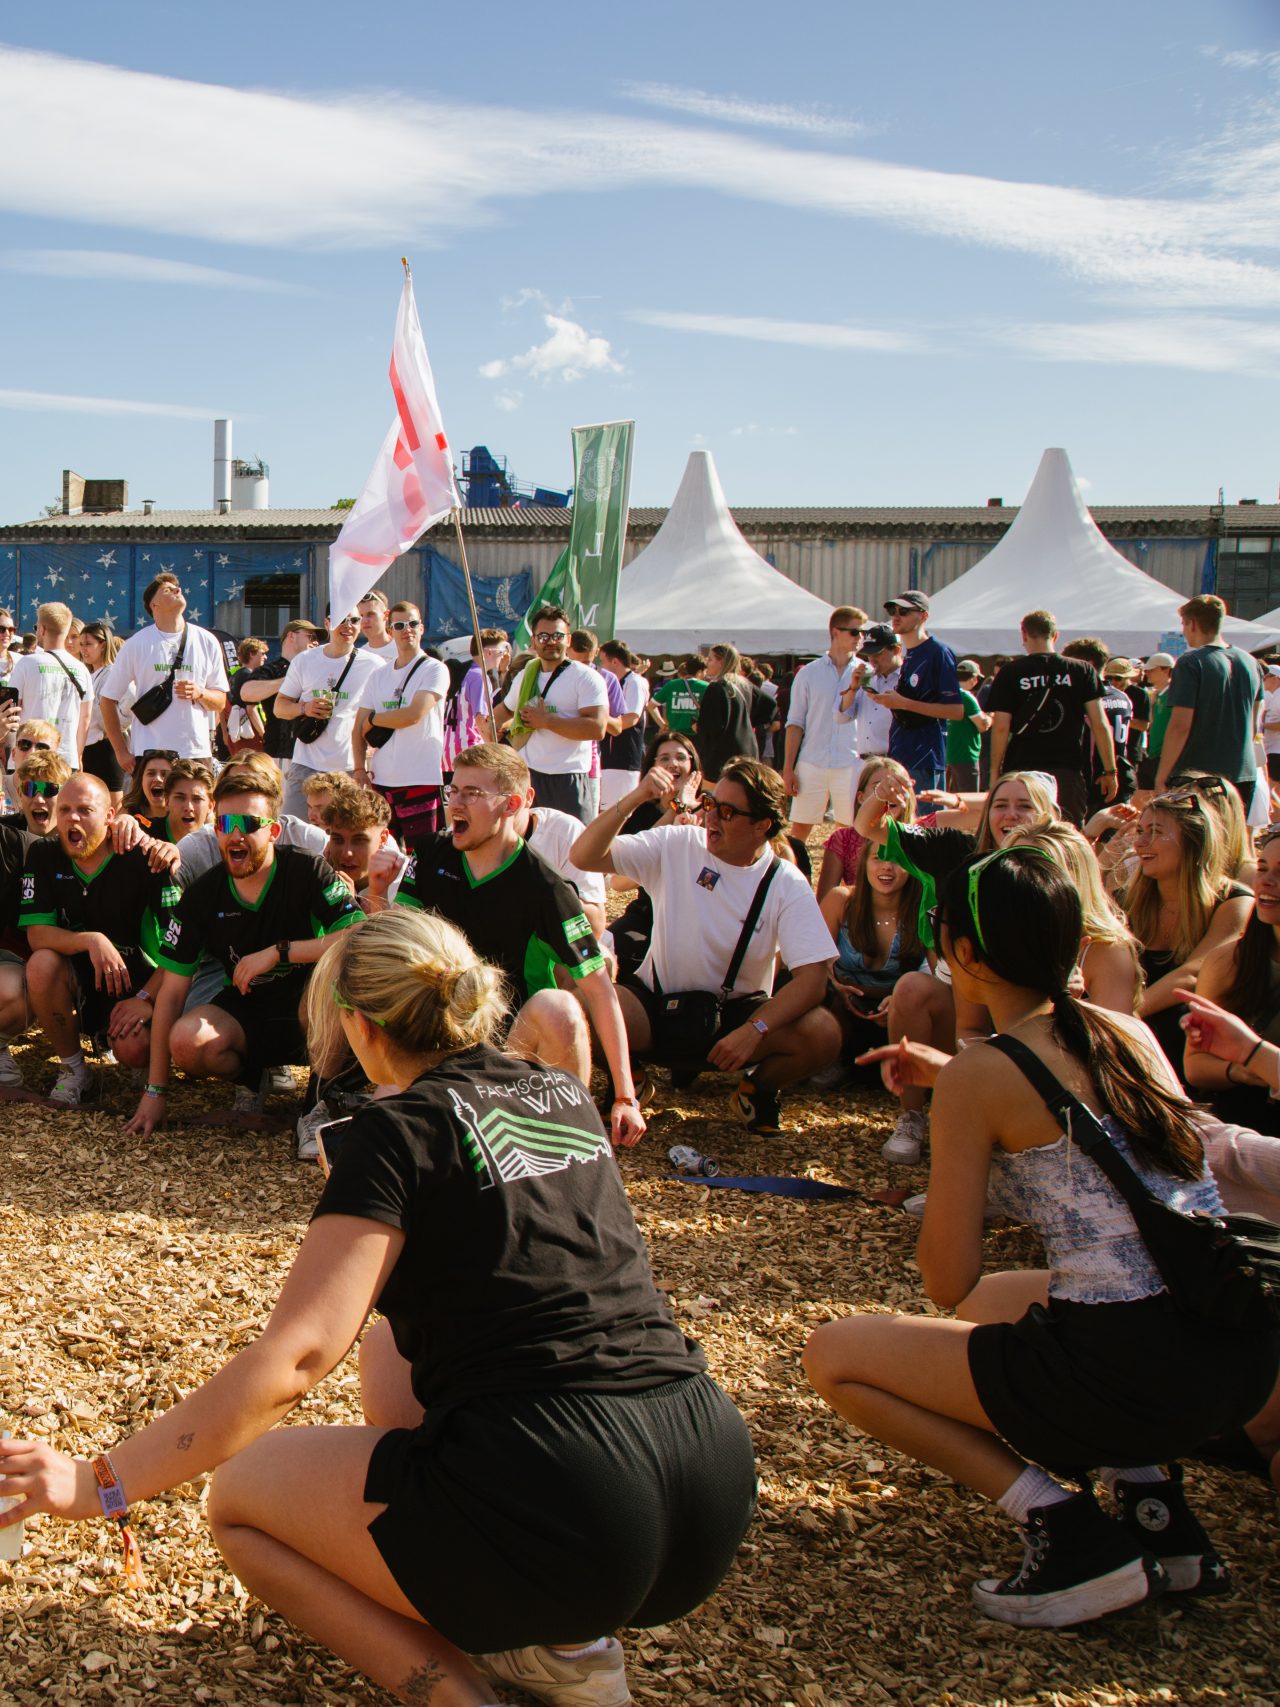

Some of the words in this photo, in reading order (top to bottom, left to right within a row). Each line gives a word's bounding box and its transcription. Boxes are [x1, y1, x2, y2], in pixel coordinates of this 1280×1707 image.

[154, 663, 193, 673] WUPTAL
[474, 1071, 569, 1099] FACHSCHAF
[521, 1084, 591, 1115] WIWI
